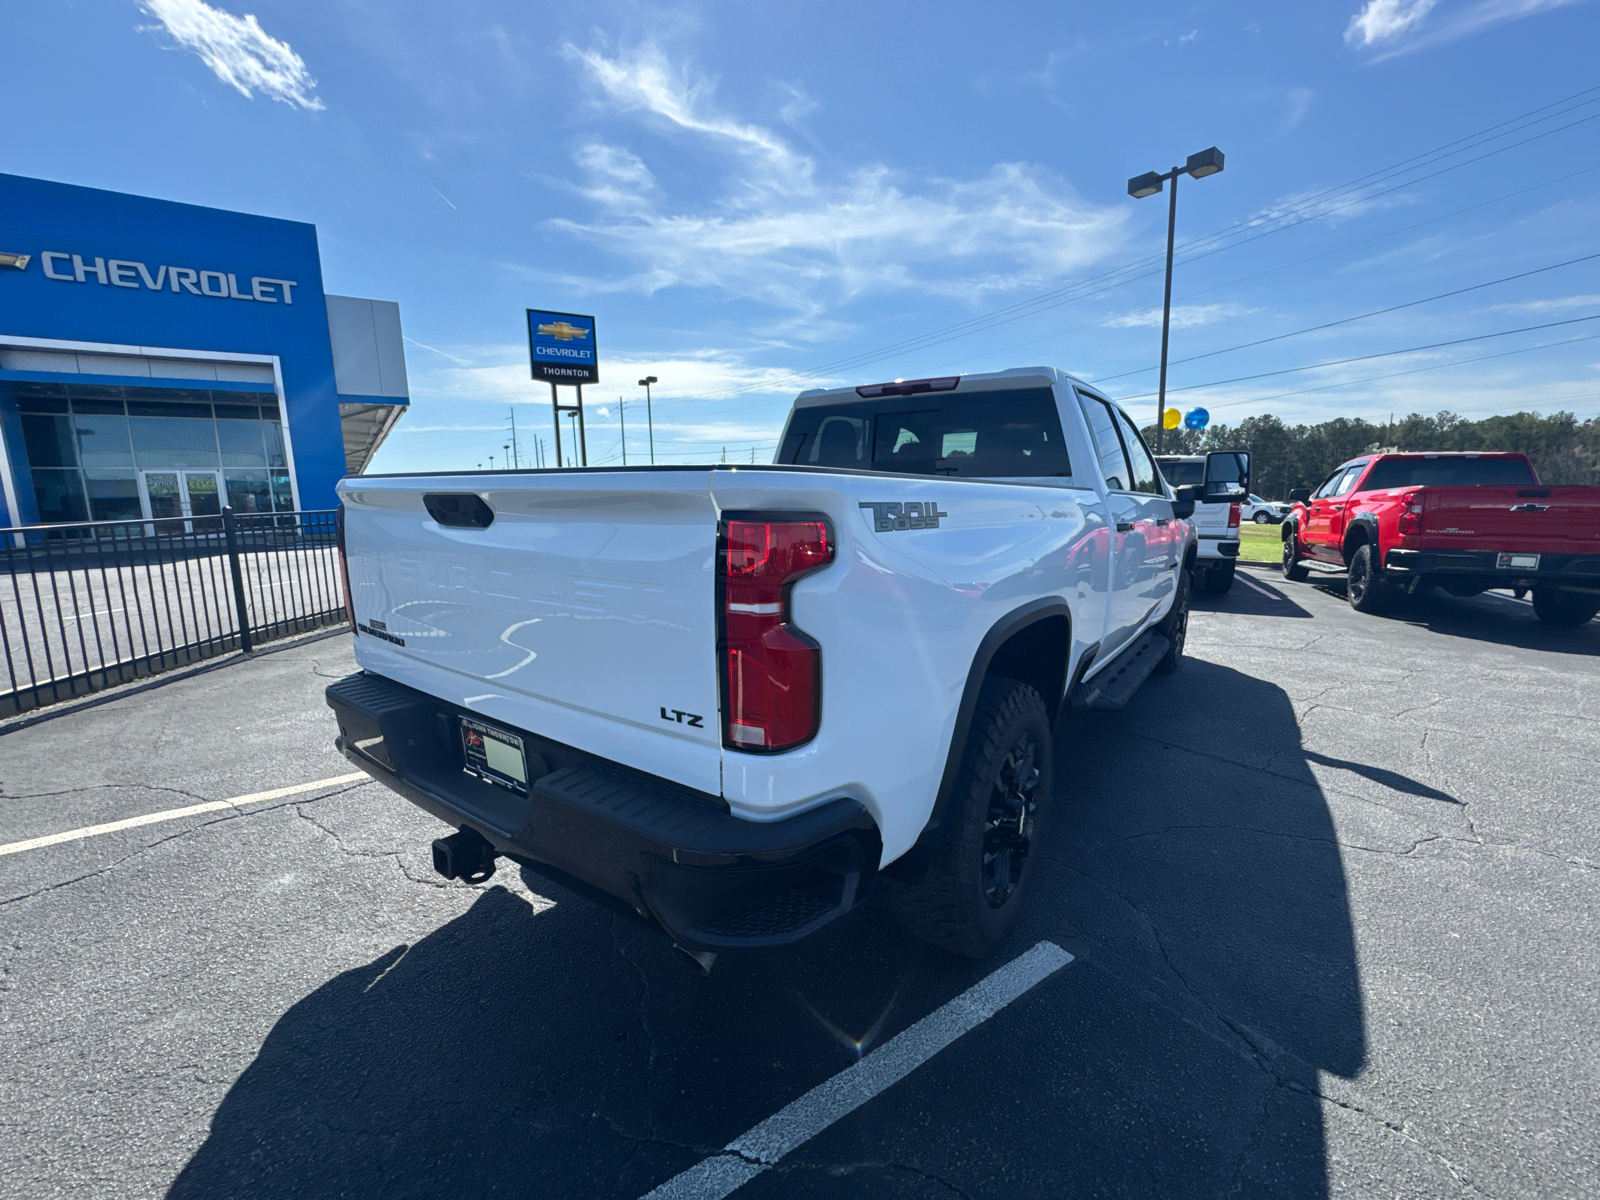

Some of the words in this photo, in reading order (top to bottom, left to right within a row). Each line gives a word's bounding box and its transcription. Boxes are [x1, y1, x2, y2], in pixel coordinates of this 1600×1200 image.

[41, 250, 298, 305] CHEVROLET
[536, 346, 591, 359] CHEVROLET
[543, 367, 589, 377] THORNTON
[858, 502, 948, 518] TRAIL
[875, 517, 940, 533] BOSS
[660, 706, 704, 729] LTZ
[472, 722, 487, 734] JOHN
